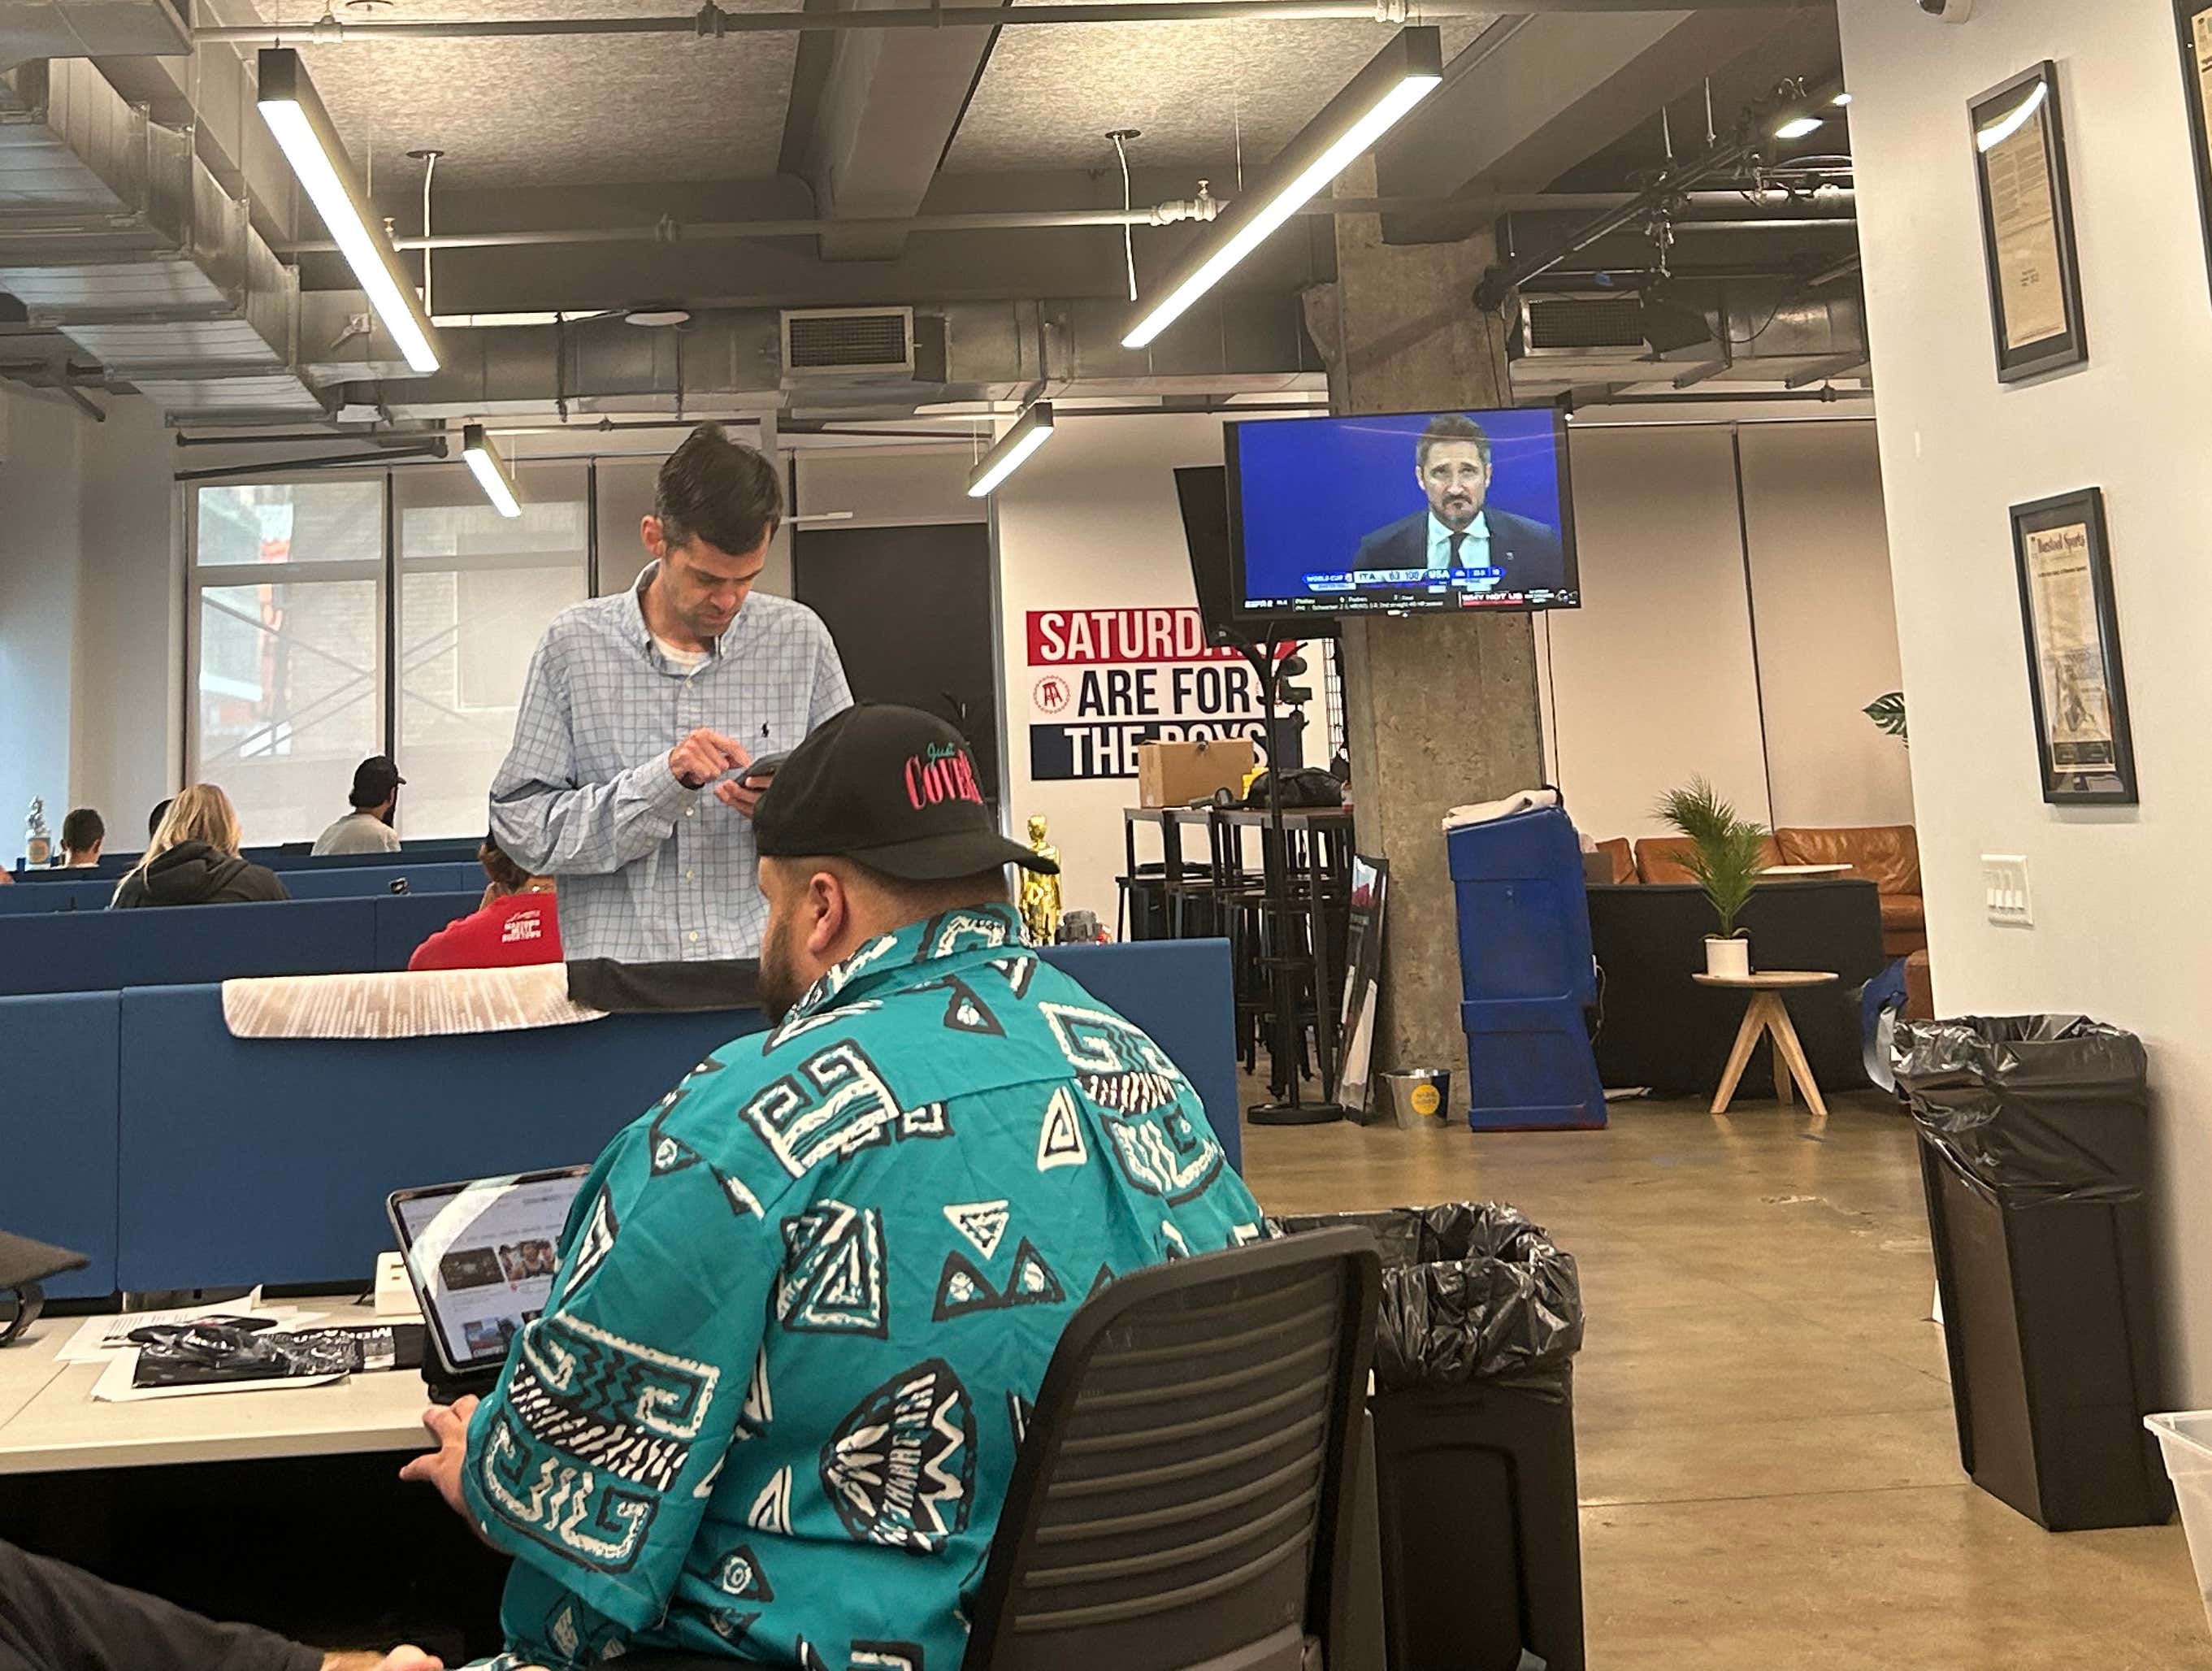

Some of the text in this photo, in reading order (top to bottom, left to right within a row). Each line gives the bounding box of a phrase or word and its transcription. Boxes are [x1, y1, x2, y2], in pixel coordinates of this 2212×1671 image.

[1040, 610, 1282, 661] SATURD
[1078, 668, 1159, 717] ARE
[1173, 666, 1251, 714] FOR
[1064, 724, 1145, 776] THE
